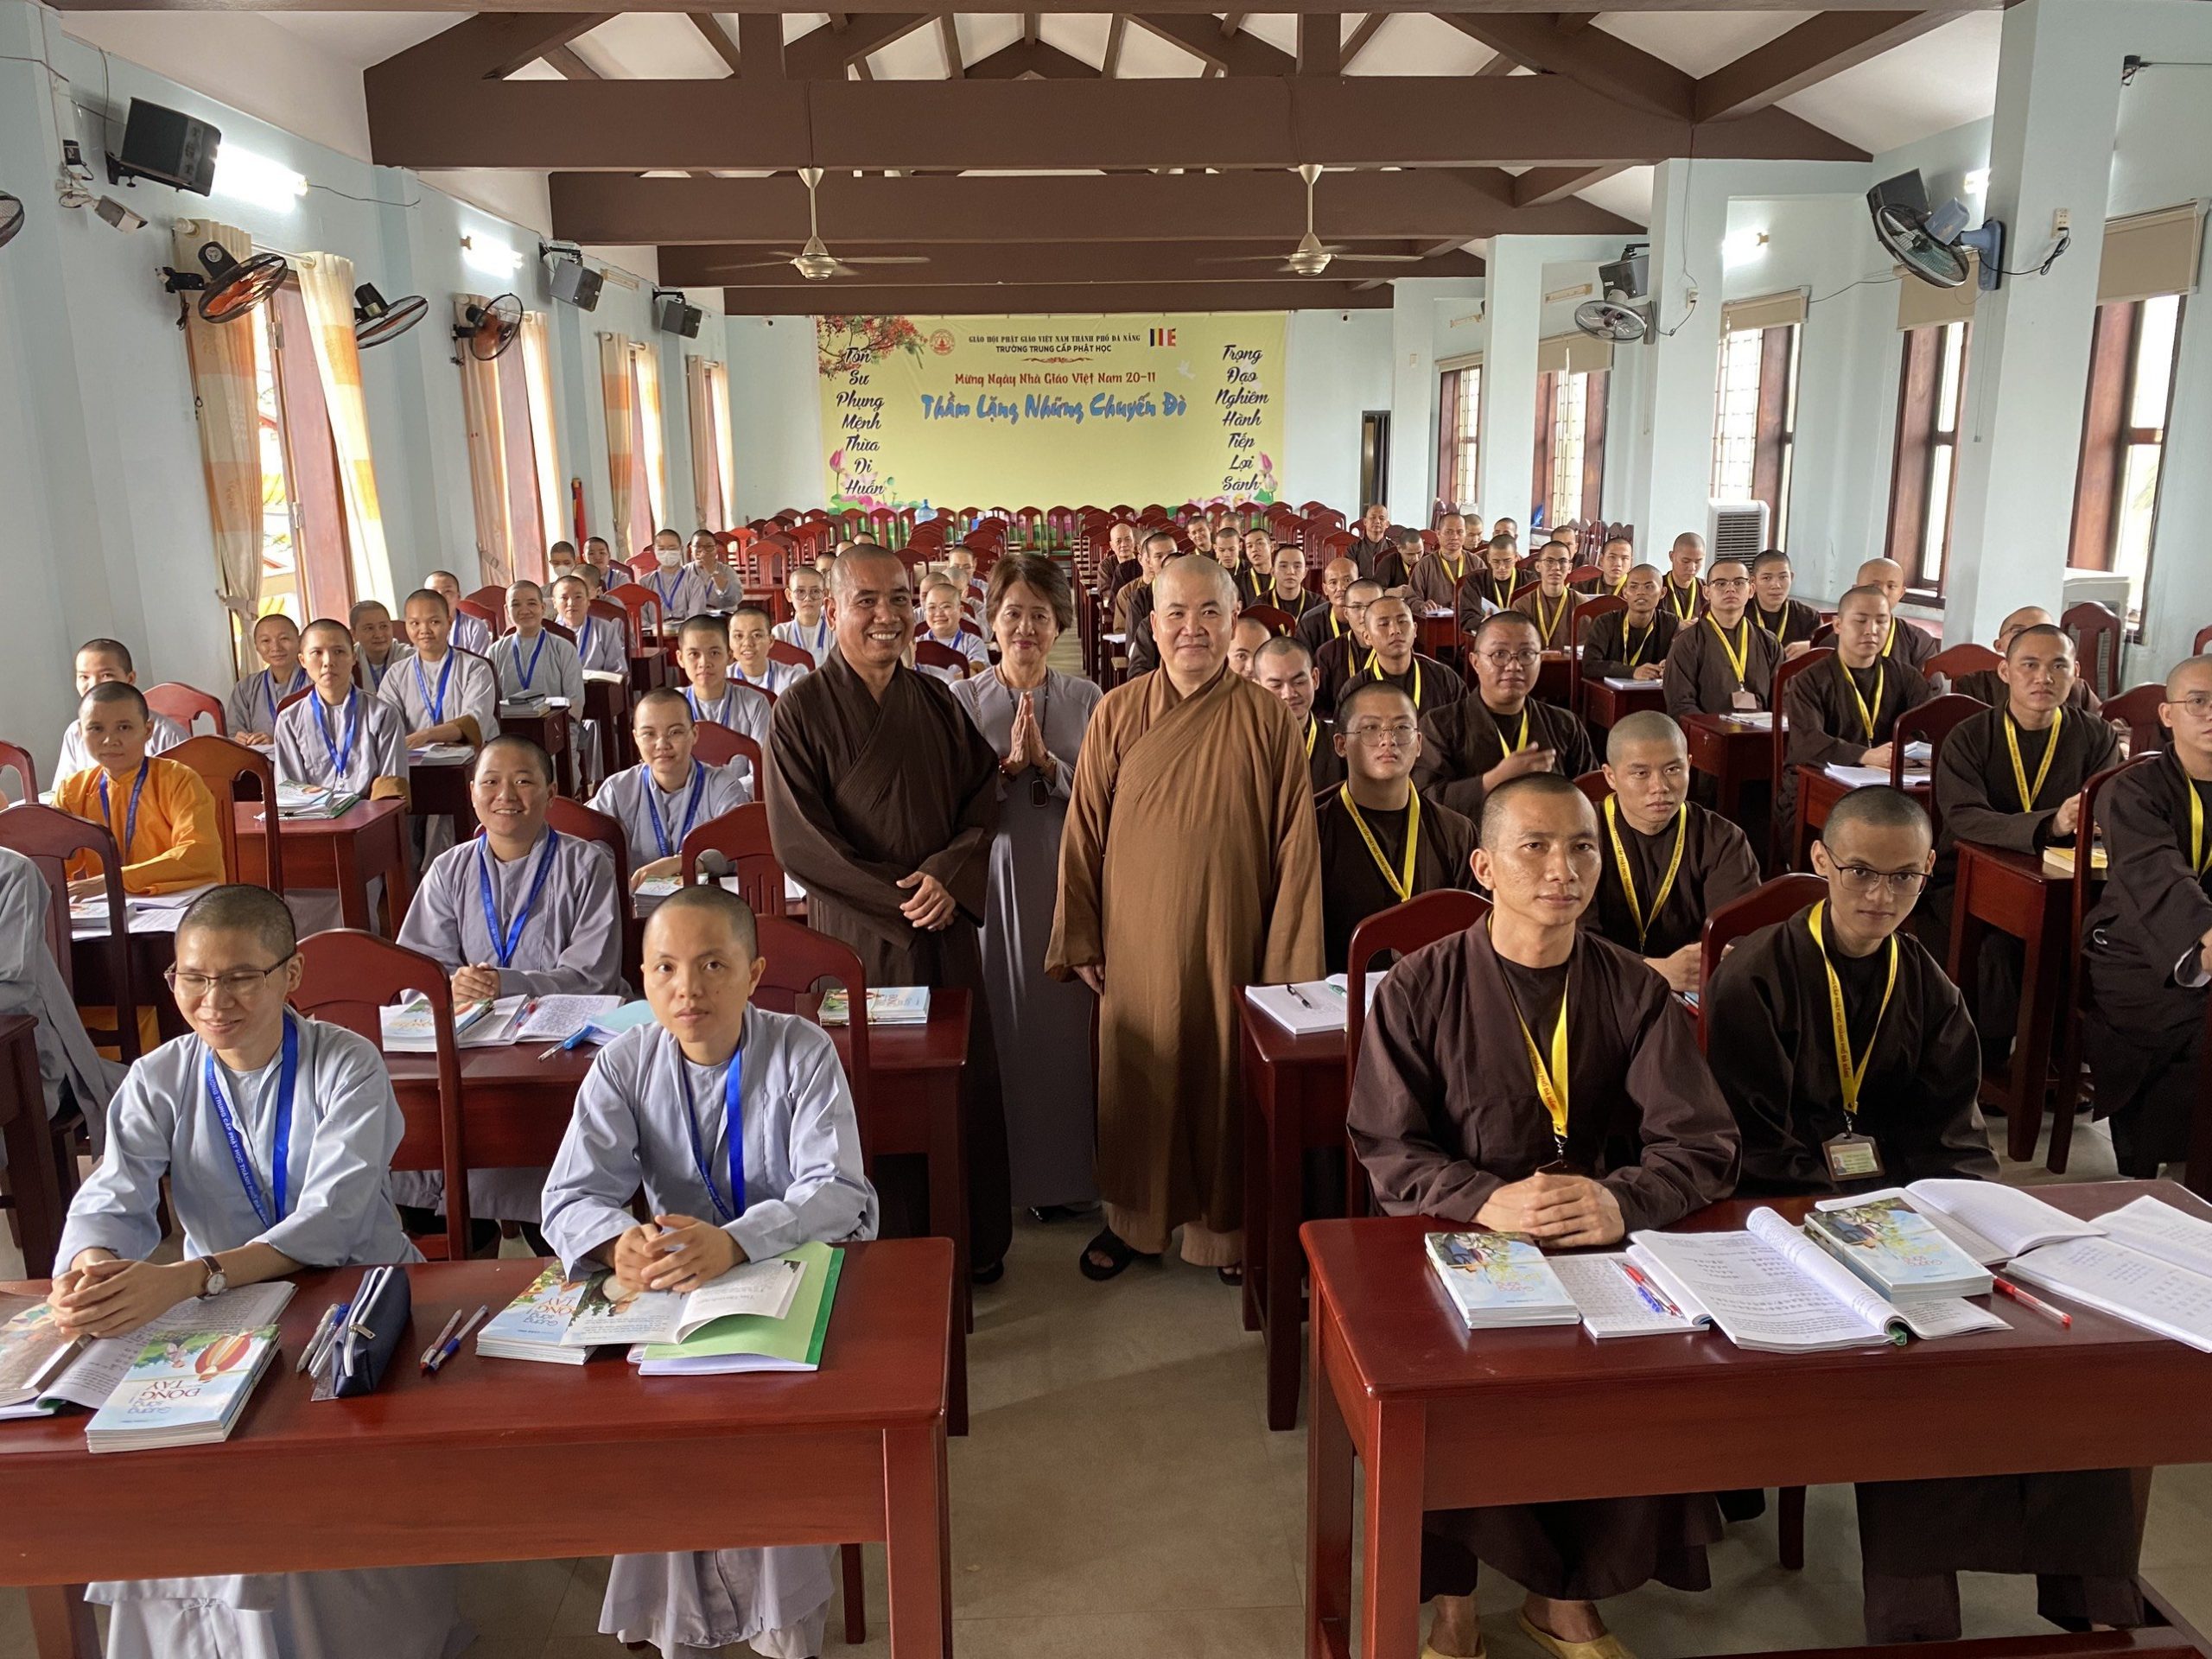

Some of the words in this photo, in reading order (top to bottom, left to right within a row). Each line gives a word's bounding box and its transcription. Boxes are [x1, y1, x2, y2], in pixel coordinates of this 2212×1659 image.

[844, 346, 871, 363] Tôn
[1056, 343, 1071, 353] CẤP
[1073, 343, 1094, 353] PHẬT
[1096, 345, 1112, 353] HỌC
[1223, 345, 1263, 364] Trọng
[849, 370, 869, 385] Sư
[955, 373, 984, 387] Mừng
[988, 373, 1016, 387] Ngày
[1020, 373, 1041, 384] Nhà
[1044, 372, 1068, 384] Giáo
[1071, 372, 1094, 385] Việt
[1098, 372, 1122, 383] Nam
[1126, 372, 1156, 383] 20-11
[1227, 366, 1258, 385] Đạo
[836, 390, 885, 412] Phụng
[1215, 387, 1269, 409] Nghiêm
[920, 391, 970, 420] Thầm
[976, 394, 1019, 425] Lặng
[1025, 394, 1084, 424] Những
[1090, 391, 1156, 423] Chuyến
[1162, 391, 1187, 416] Đò
[842, 412, 881, 432] Mệnh
[1222, 409, 1262, 427] Hành
[845, 434, 880, 452] Thừa
[1228, 432, 1255, 452] Tiếp
[845, 479, 886, 495] Huấn
